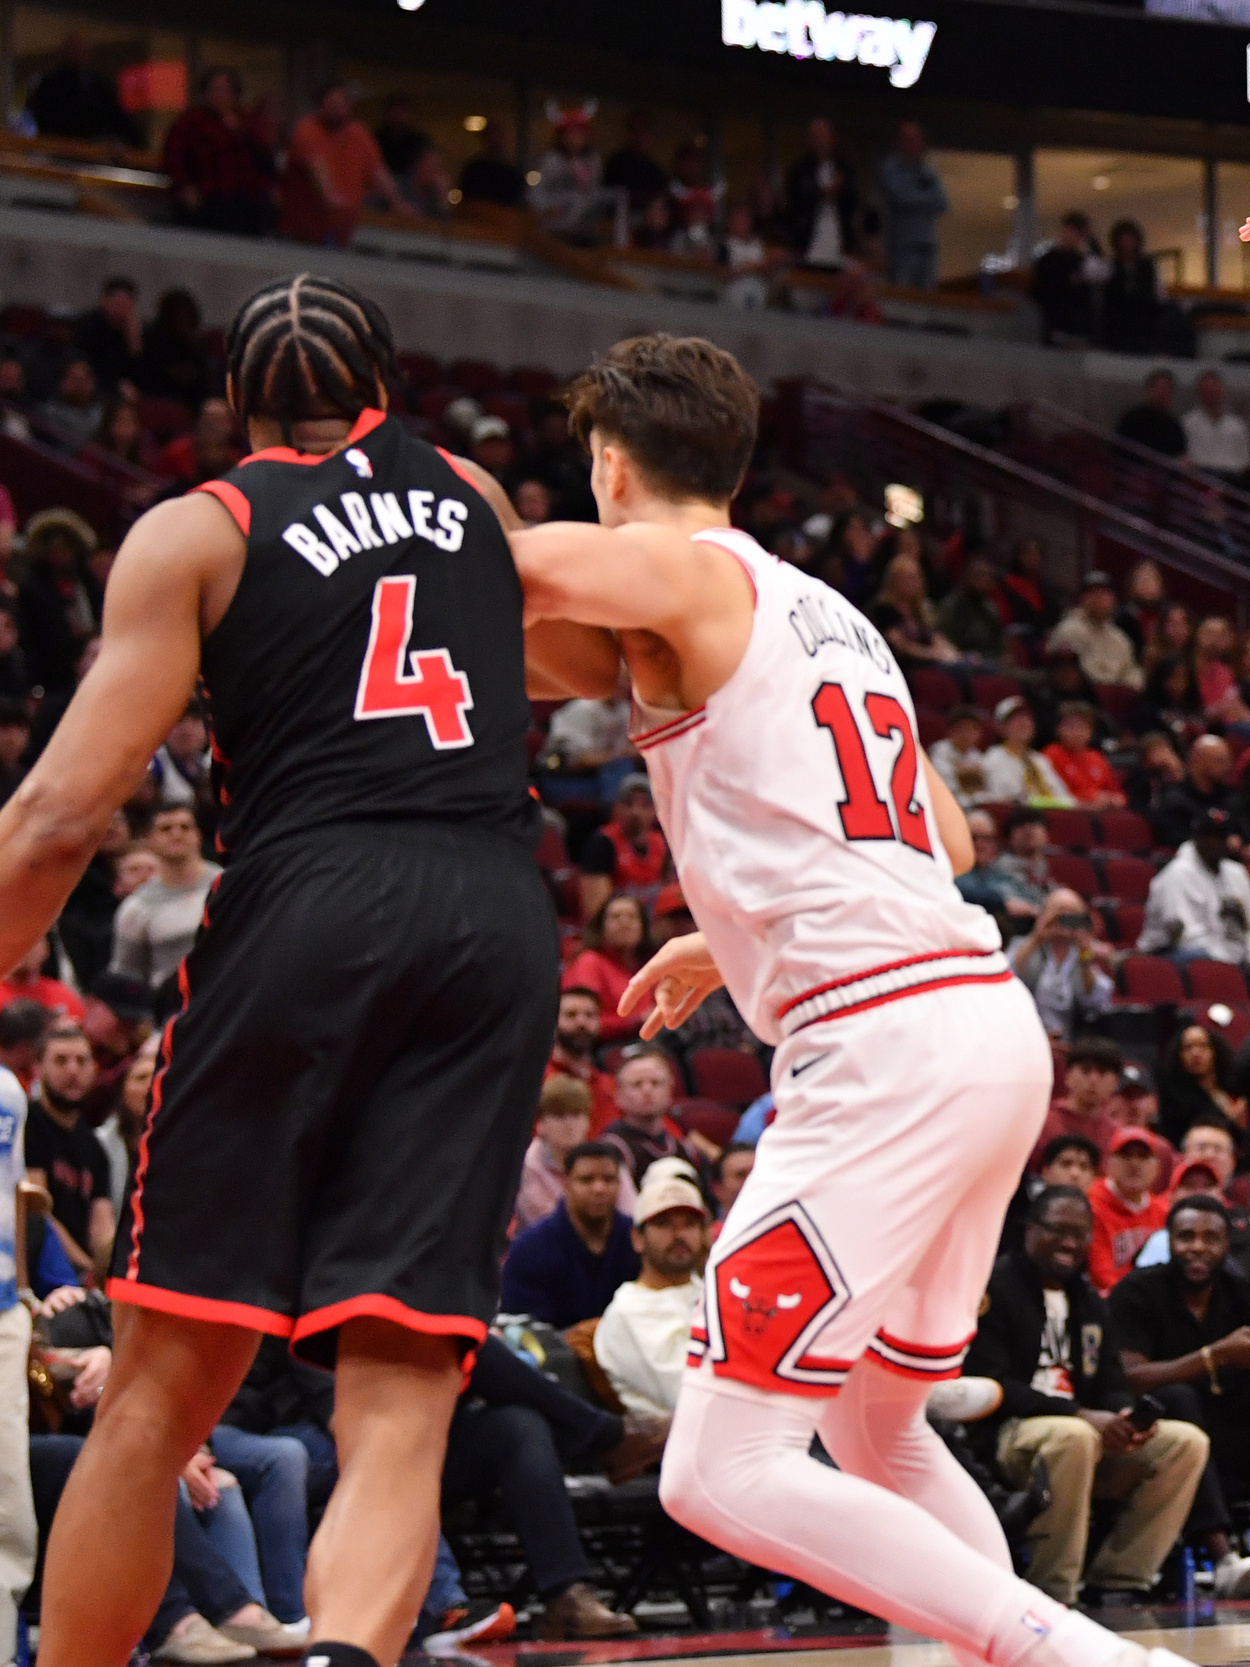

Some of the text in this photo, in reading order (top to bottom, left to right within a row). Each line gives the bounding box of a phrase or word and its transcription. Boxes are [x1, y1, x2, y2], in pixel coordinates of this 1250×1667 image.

[721, 0, 936, 88] betway
[282, 489, 468, 577] BARNES
[353, 573, 475, 750] 4
[789, 594, 890, 674] COLLINS
[811, 681, 935, 860] 12
